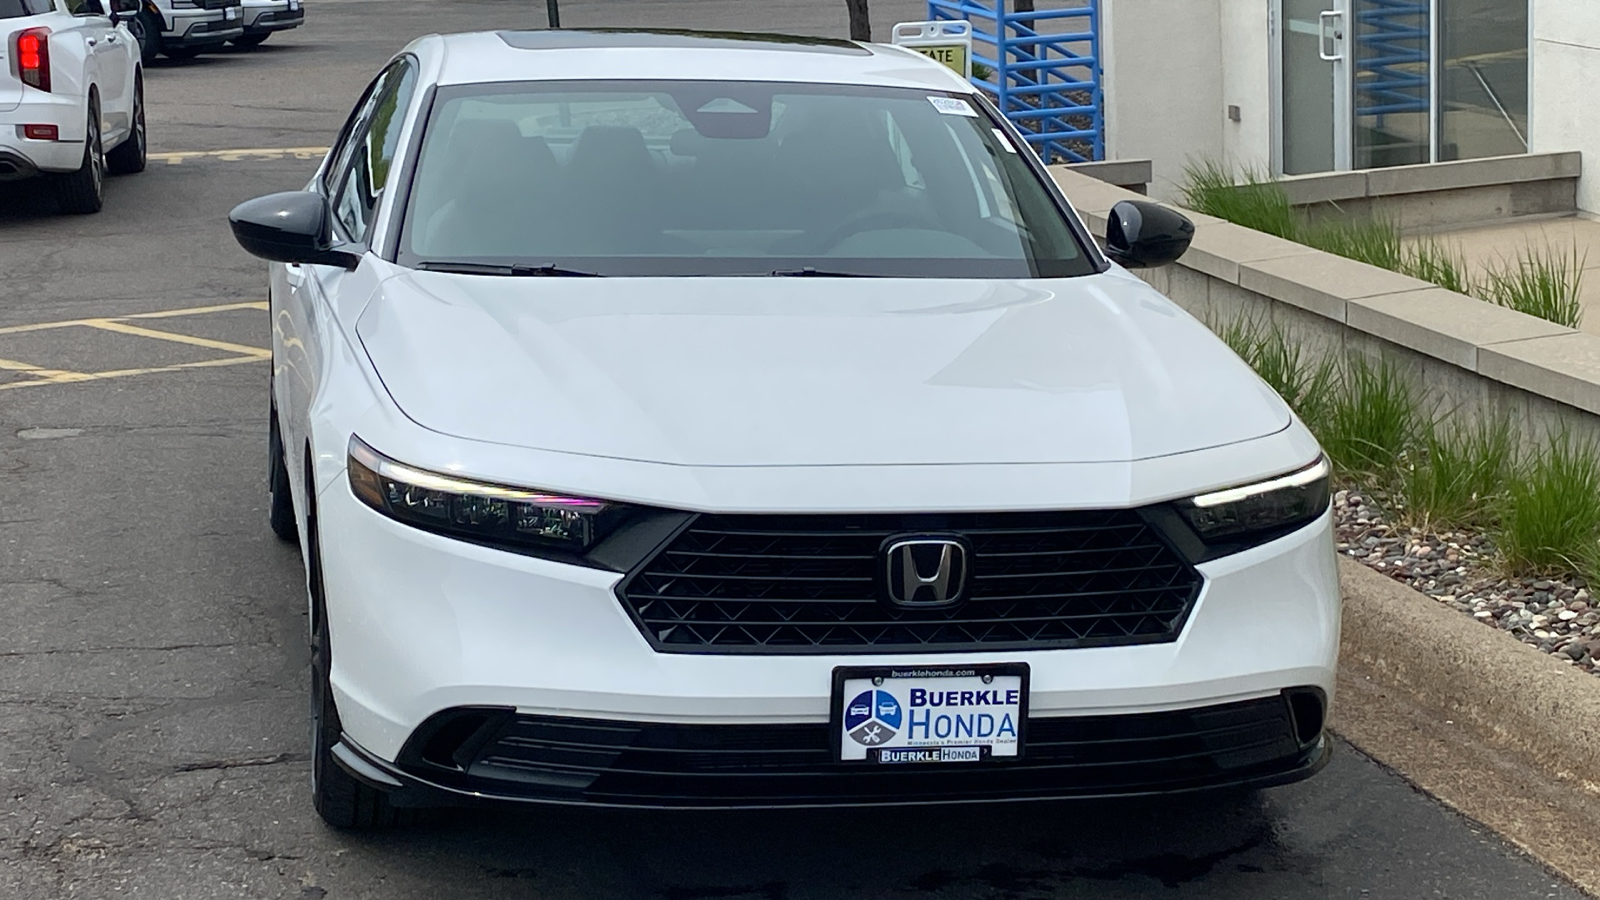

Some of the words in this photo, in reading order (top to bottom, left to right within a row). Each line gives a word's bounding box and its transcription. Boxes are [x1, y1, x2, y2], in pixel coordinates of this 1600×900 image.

[919, 50, 953, 62] ATE
[891, 669, 975, 678] buerklehonda.com
[910, 688, 1018, 707] BUERKLE
[908, 709, 1016, 739] HONDA
